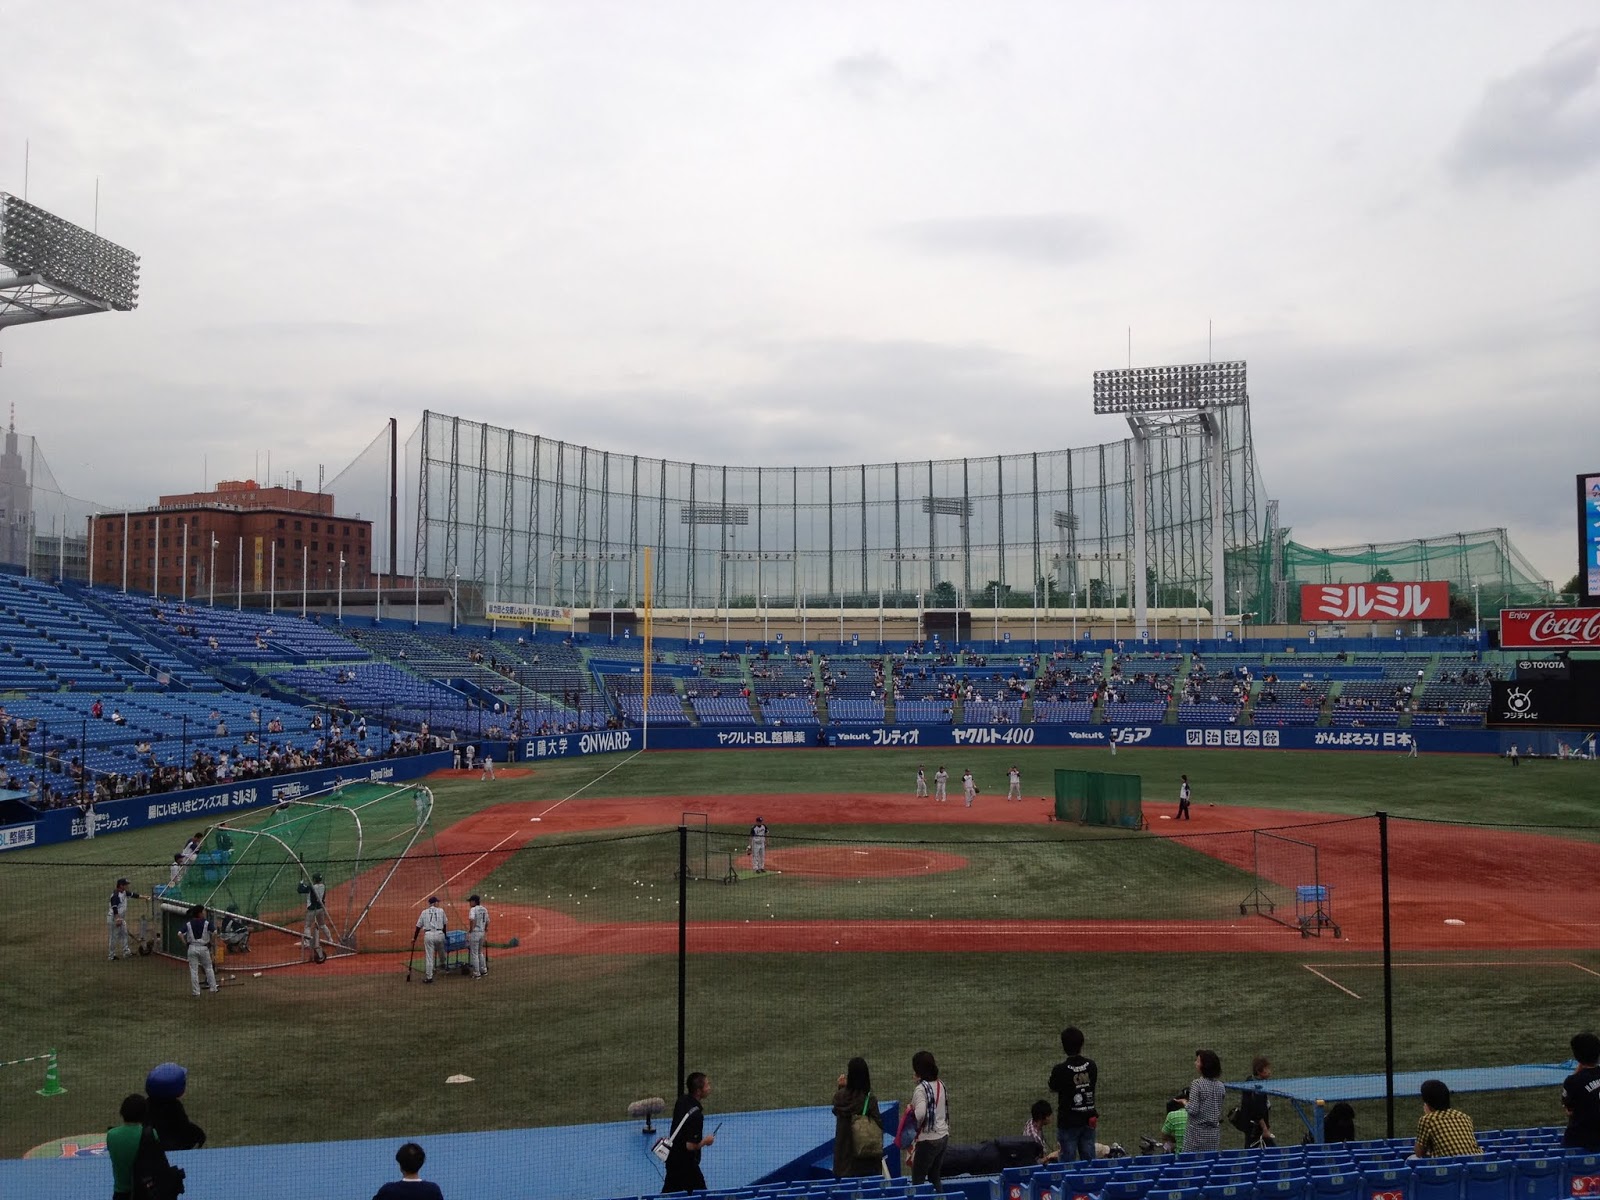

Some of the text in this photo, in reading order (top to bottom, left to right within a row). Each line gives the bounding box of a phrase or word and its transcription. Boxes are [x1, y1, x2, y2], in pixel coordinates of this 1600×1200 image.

[1318, 585, 1430, 618] ミルミル
[1508, 611, 1531, 621] Enjoy
[579, 731, 631, 753] ONWARD
[717, 731, 805, 744] ヤクルトBL整腸薬
[837, 729, 919, 745] Yakult プレティオ
[951, 727, 1034, 744] ヤクルト400
[1069, 728, 1151, 744] Yakult ジョア
[1187, 730, 1279, 746] 明治記念館
[148, 788, 258, 820] 腸にいきいきビフィズス菌 ミルミル
[429, 912, 438, 922] 71
